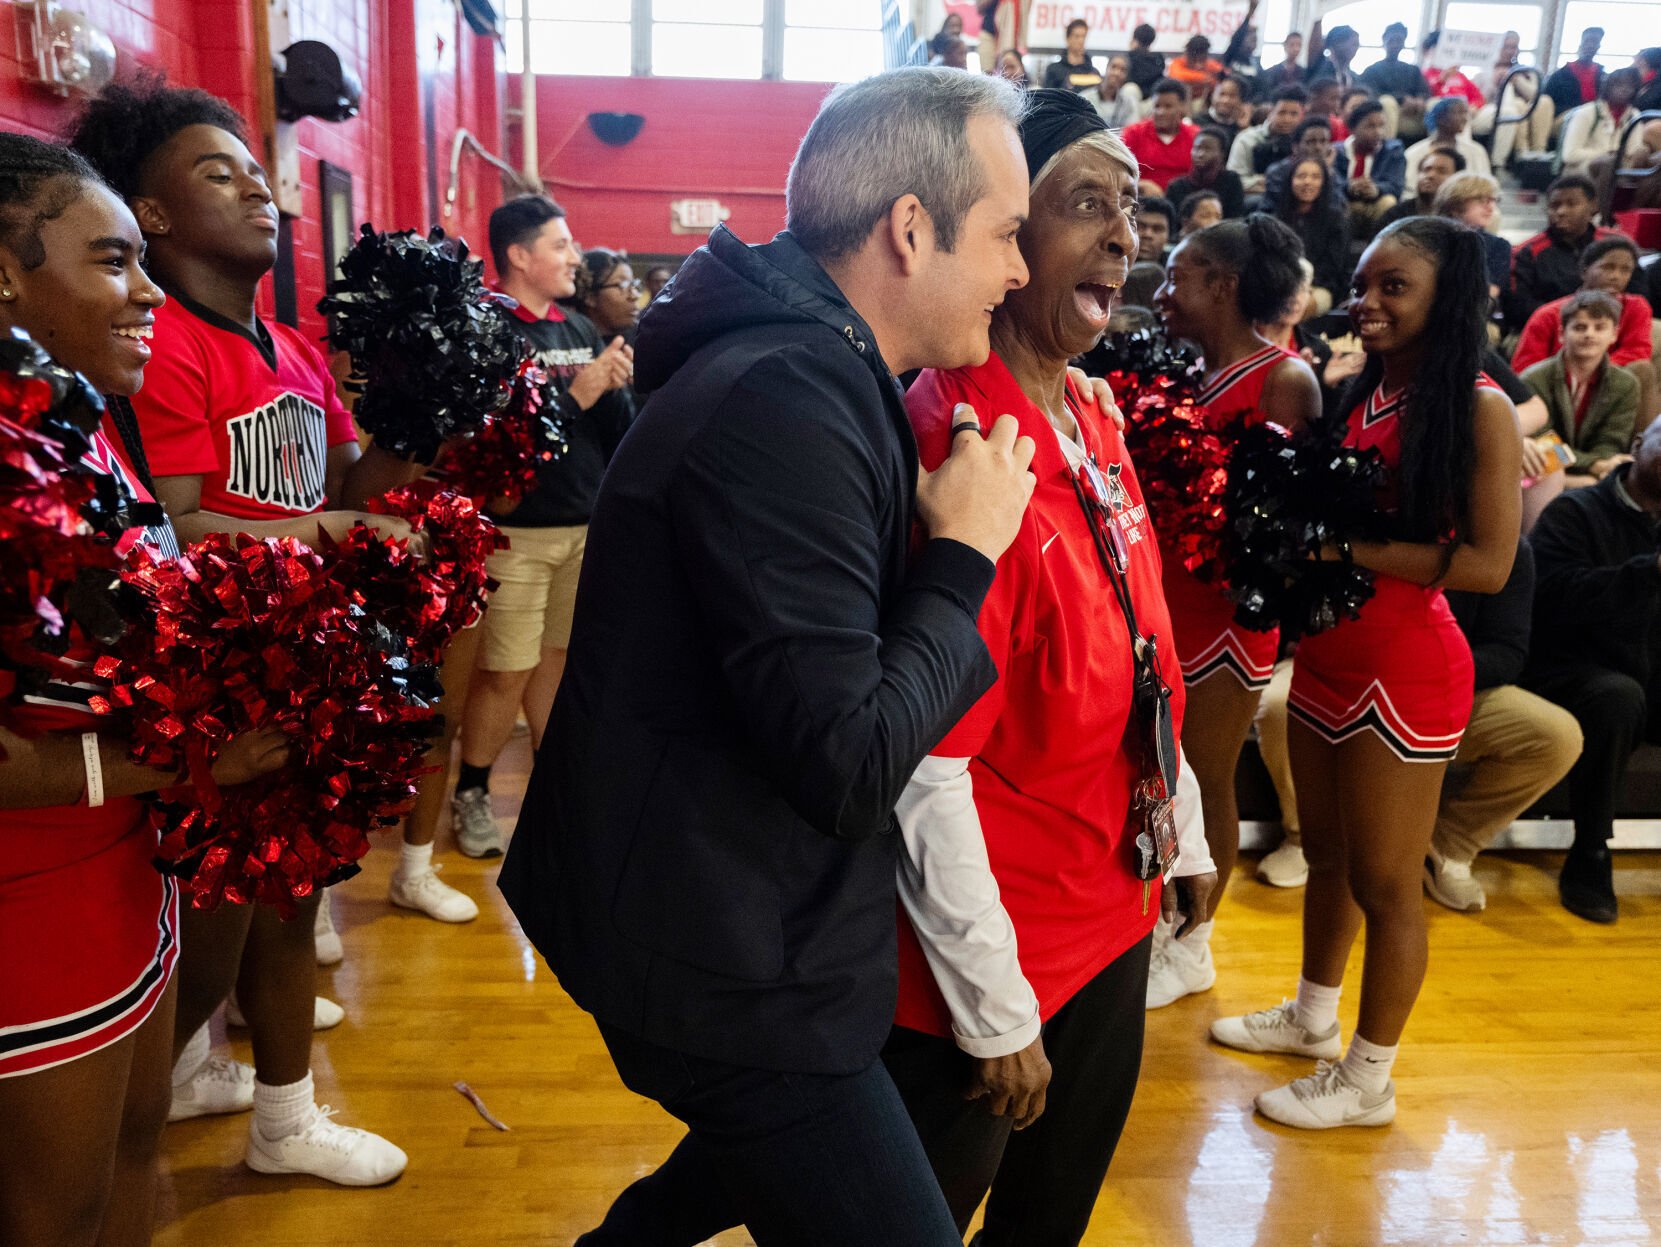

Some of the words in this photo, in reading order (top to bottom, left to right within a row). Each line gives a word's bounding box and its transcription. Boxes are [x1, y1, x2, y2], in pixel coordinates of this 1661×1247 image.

[1036, 4, 1074, 30] BIG
[1084, 6, 1147, 33] DAVE
[1155, 10, 1246, 36] CLASSI
